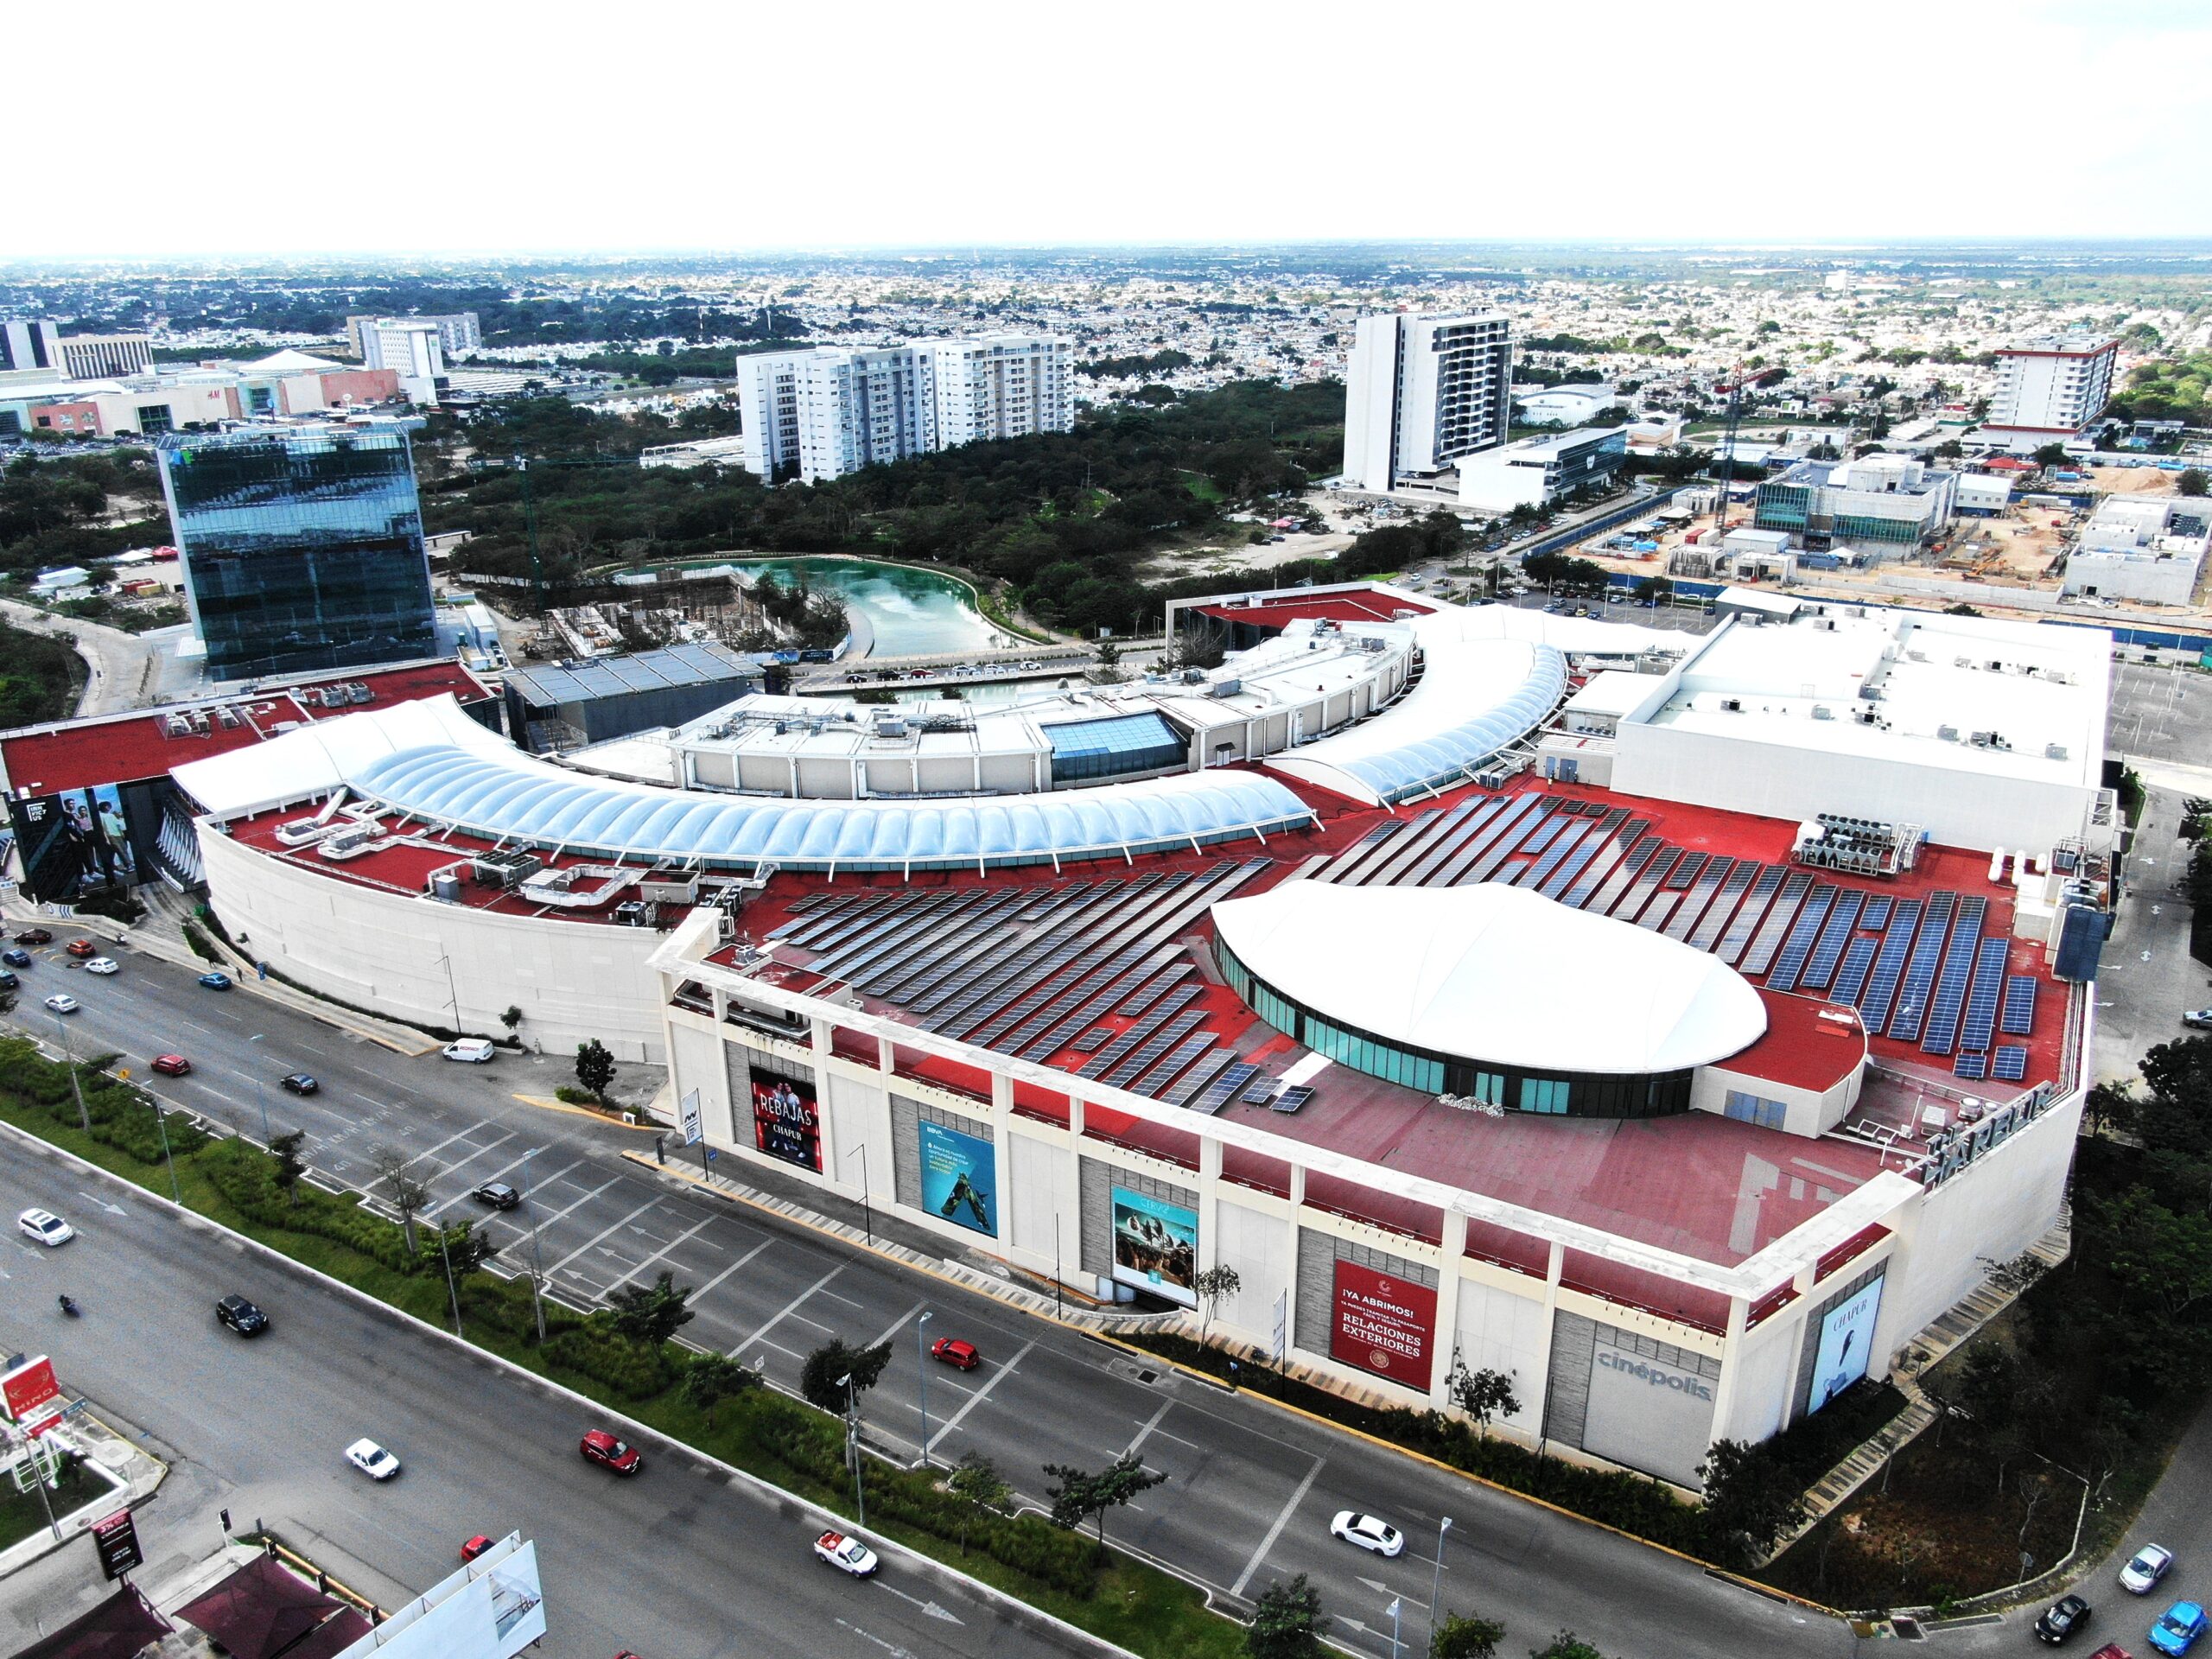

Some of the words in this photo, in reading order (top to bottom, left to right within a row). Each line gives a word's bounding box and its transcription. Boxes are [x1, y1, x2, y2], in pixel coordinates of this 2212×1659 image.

[760, 1093, 812, 1126] REBAJAS
[772, 1124, 802, 1141] CHAPUR
[926, 1127, 943, 1135] BBVA
[1343, 1288, 1359, 1300] ¡YA
[1362, 1296, 1414, 1319] ABRIMOS!
[1834, 1299, 1867, 1332] CHAPUR
[1342, 1323, 1421, 1357] EXTERIORES
[1343, 1313, 1421, 1346] RELACIONES
[1598, 1351, 1712, 1402] cinépolis
[15, 1388, 53, 1412] HINO
